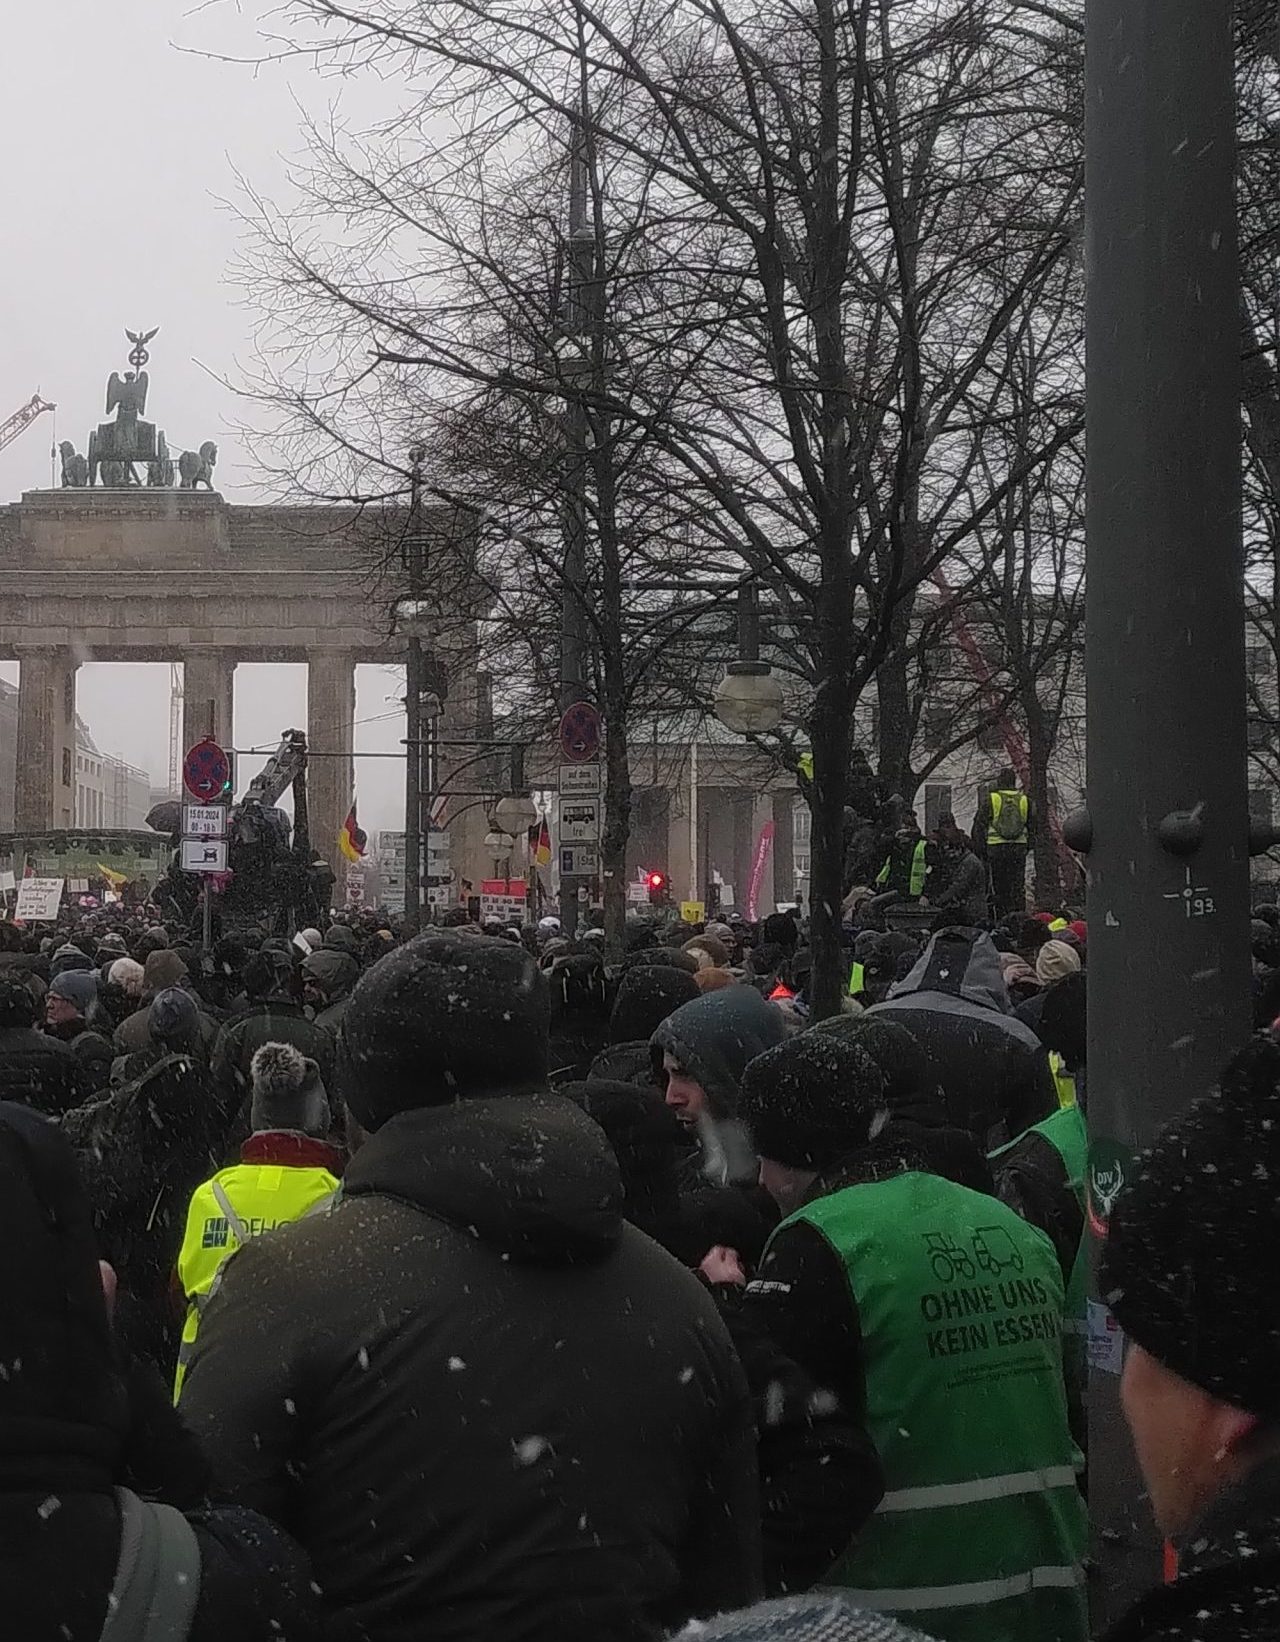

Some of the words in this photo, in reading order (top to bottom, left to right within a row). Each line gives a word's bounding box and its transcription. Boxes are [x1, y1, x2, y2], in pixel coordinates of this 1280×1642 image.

[190, 809, 219, 820] 15.01.2024
[1097, 1171, 1113, 1184] DJV
[920, 1285, 997, 1322] OHNE
[998, 1277, 1048, 1309] UNS
[927, 1323, 990, 1358] KEIN
[993, 1309, 1058, 1347] ESSEN
